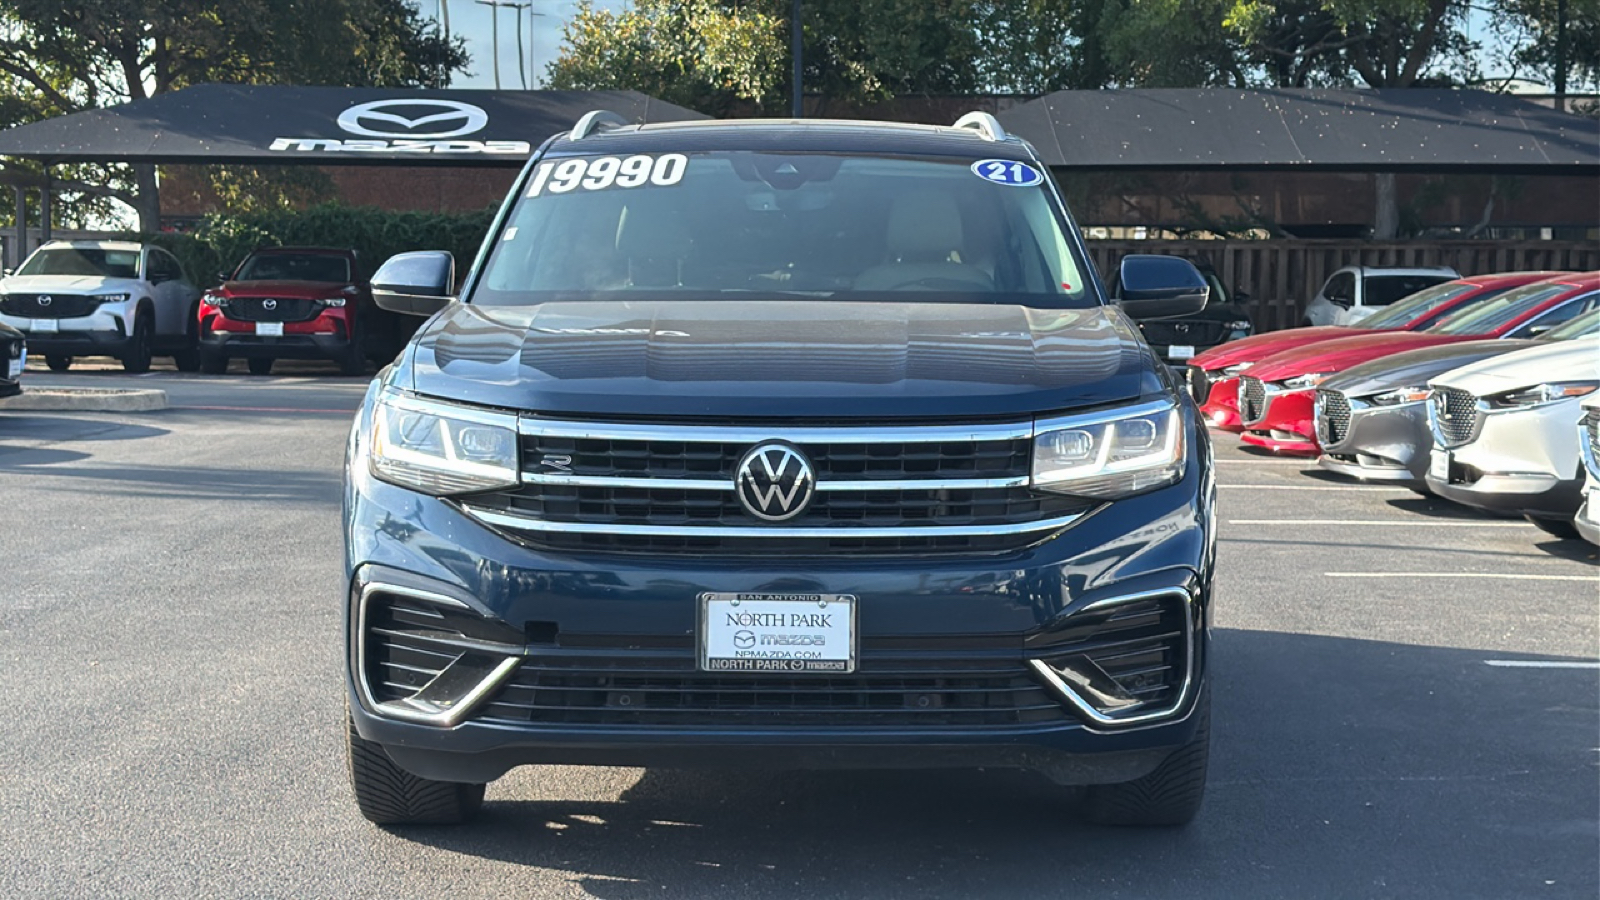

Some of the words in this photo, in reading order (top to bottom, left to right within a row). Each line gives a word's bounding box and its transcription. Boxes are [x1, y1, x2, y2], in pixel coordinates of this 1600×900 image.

[526, 153, 688, 198] 19990
[986, 163, 1023, 182] 21
[726, 612, 785, 628] NORTH
[790, 613, 833, 628] PARK
[711, 659, 753, 670] NORTH
[756, 660, 789, 670] PARK
